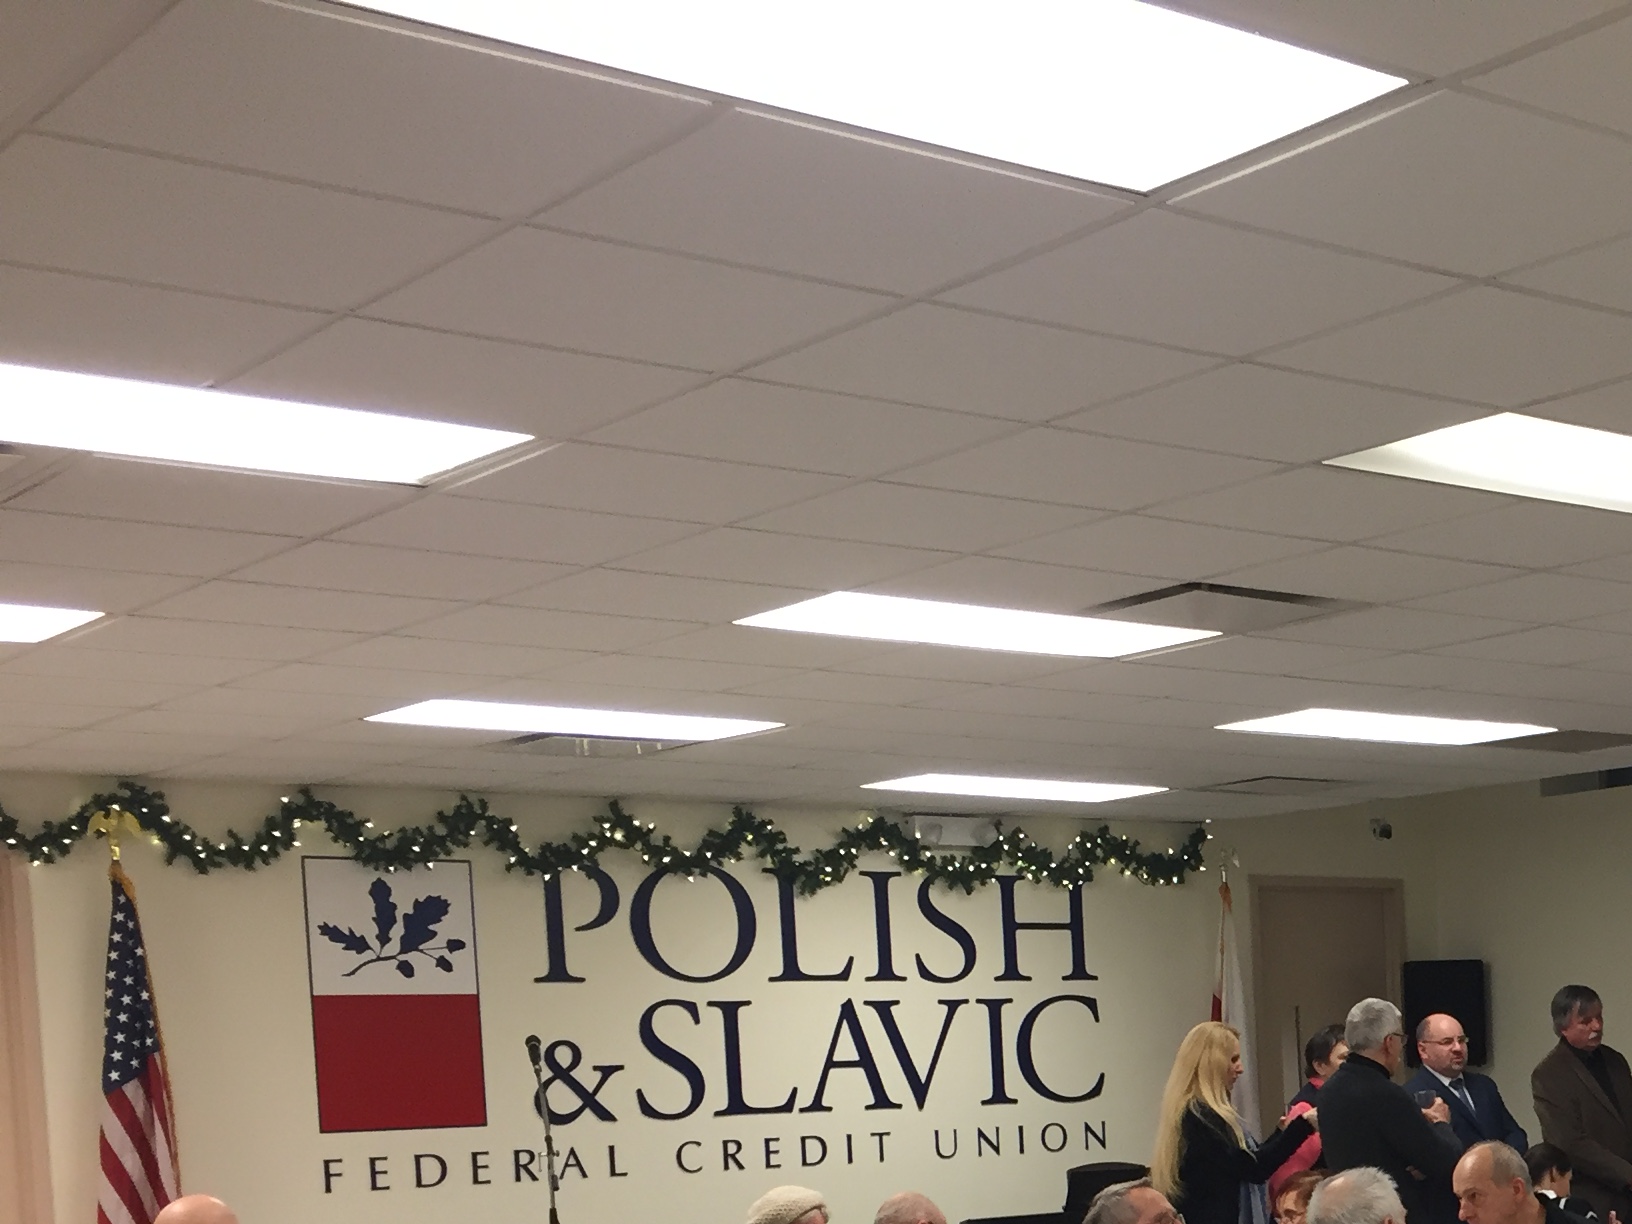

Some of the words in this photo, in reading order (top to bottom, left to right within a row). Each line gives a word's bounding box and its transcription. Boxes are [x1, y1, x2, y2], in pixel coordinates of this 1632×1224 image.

[534, 864, 1098, 984] POLISH
[635, 993, 1106, 1121] SLAVIC
[323, 1145, 629, 1194] FEDERAL
[675, 1131, 891, 1174] CREDIT
[933, 1120, 1108, 1161] UNION
